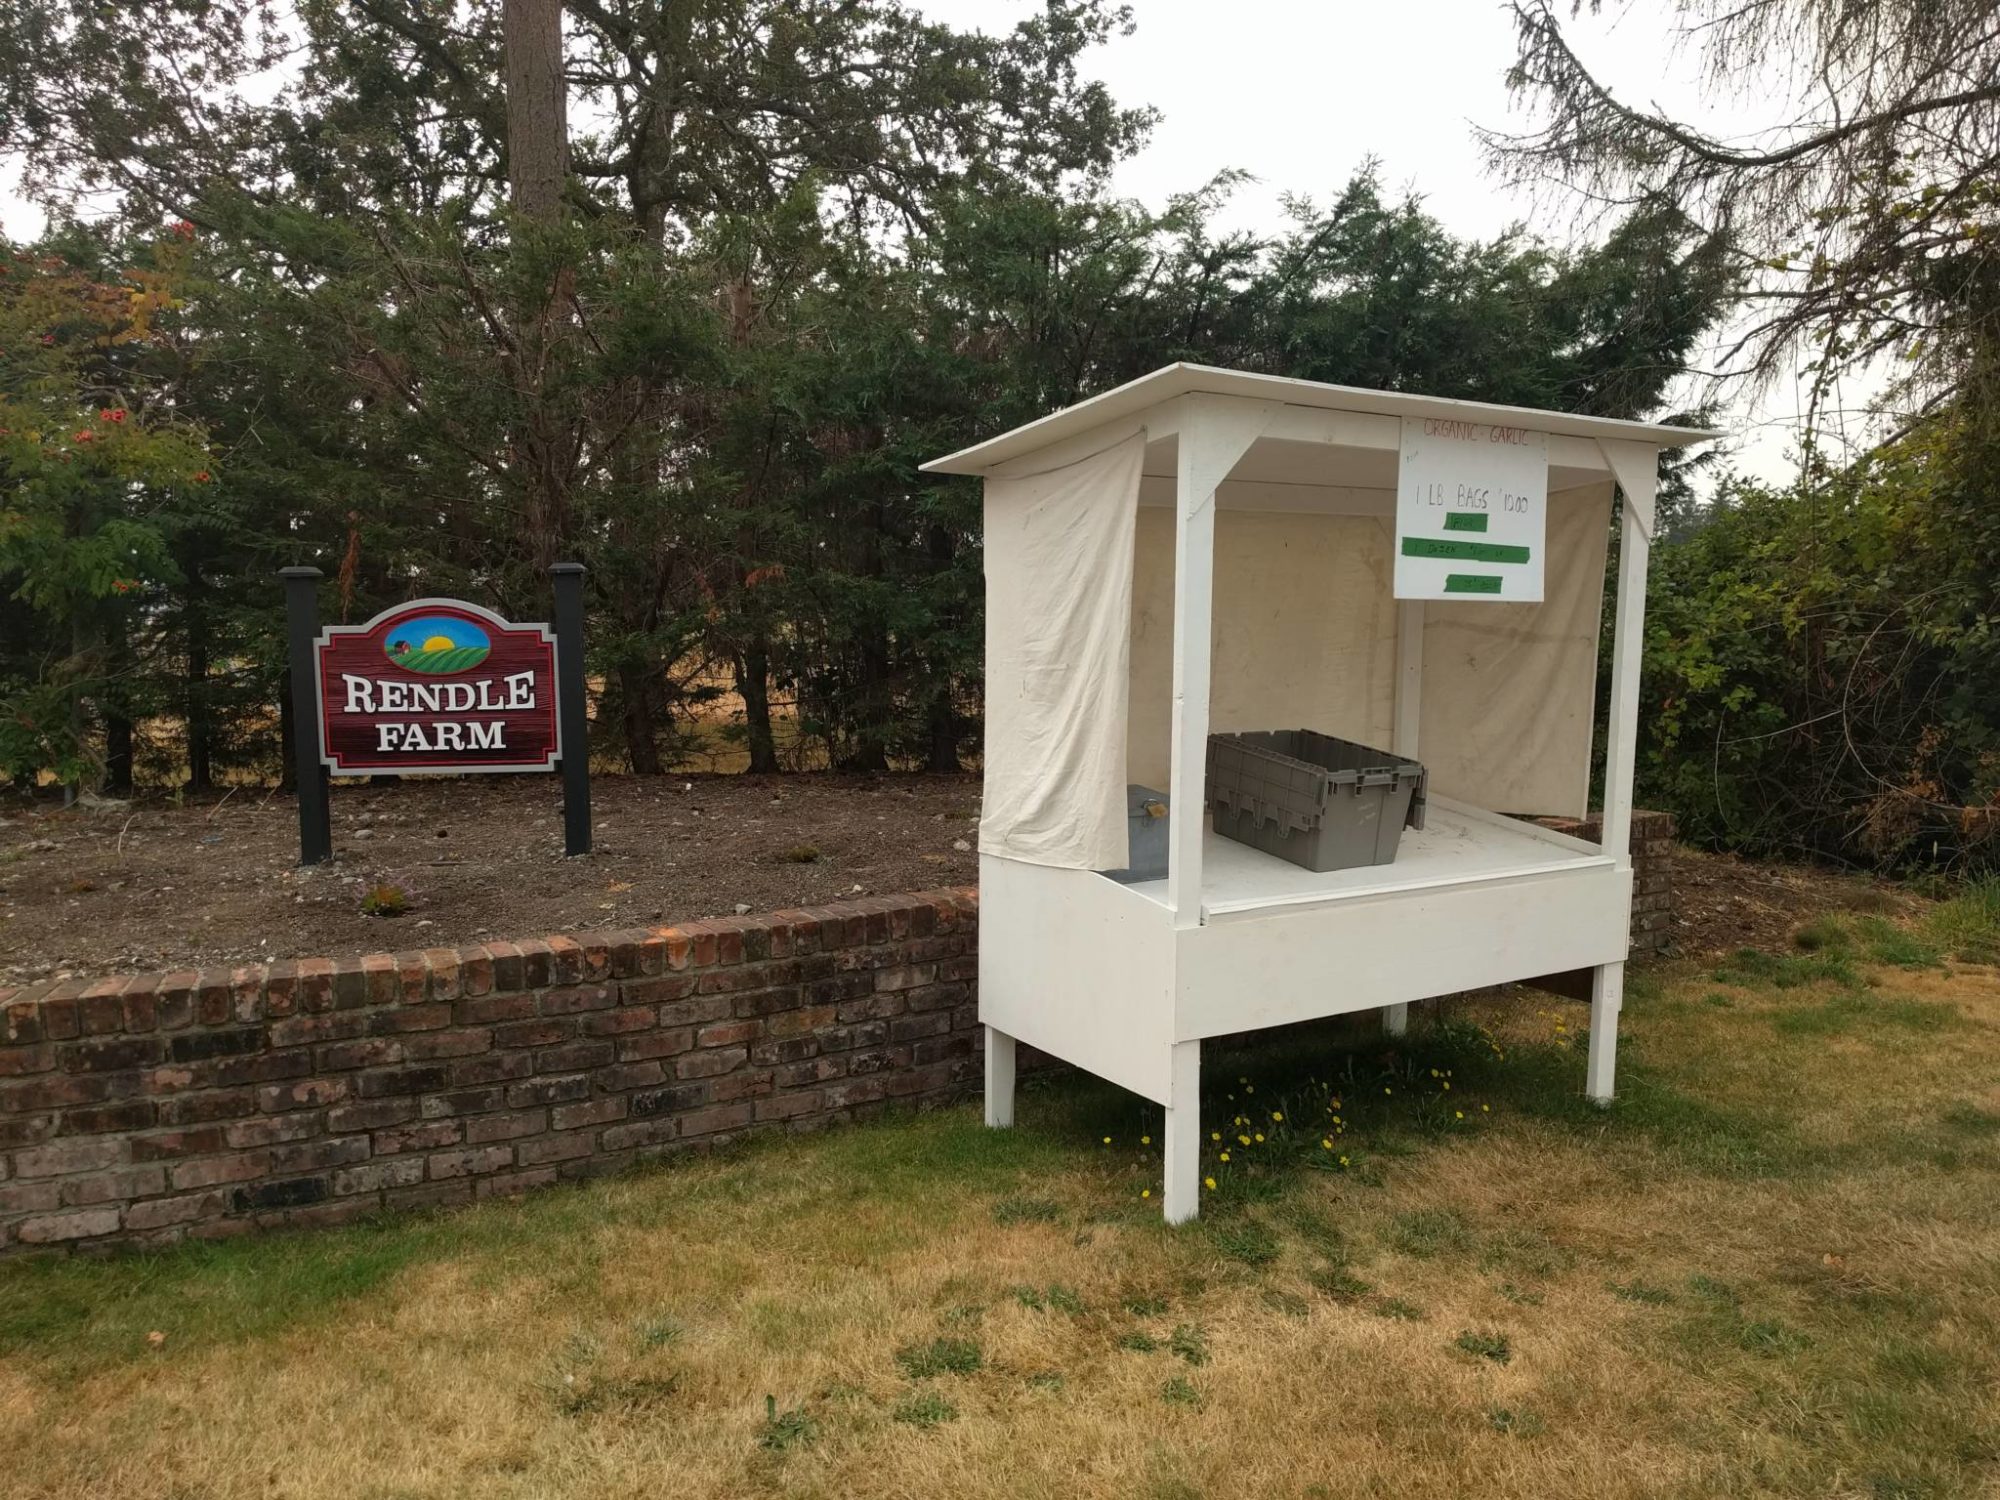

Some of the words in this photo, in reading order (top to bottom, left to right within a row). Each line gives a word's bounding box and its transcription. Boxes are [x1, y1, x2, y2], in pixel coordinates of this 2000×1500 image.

[1429, 483, 1444, 506] LB
[1457, 483, 1489, 509] BAGS
[341, 670, 536, 713] RENDLE
[375, 721, 507, 752] FARM
